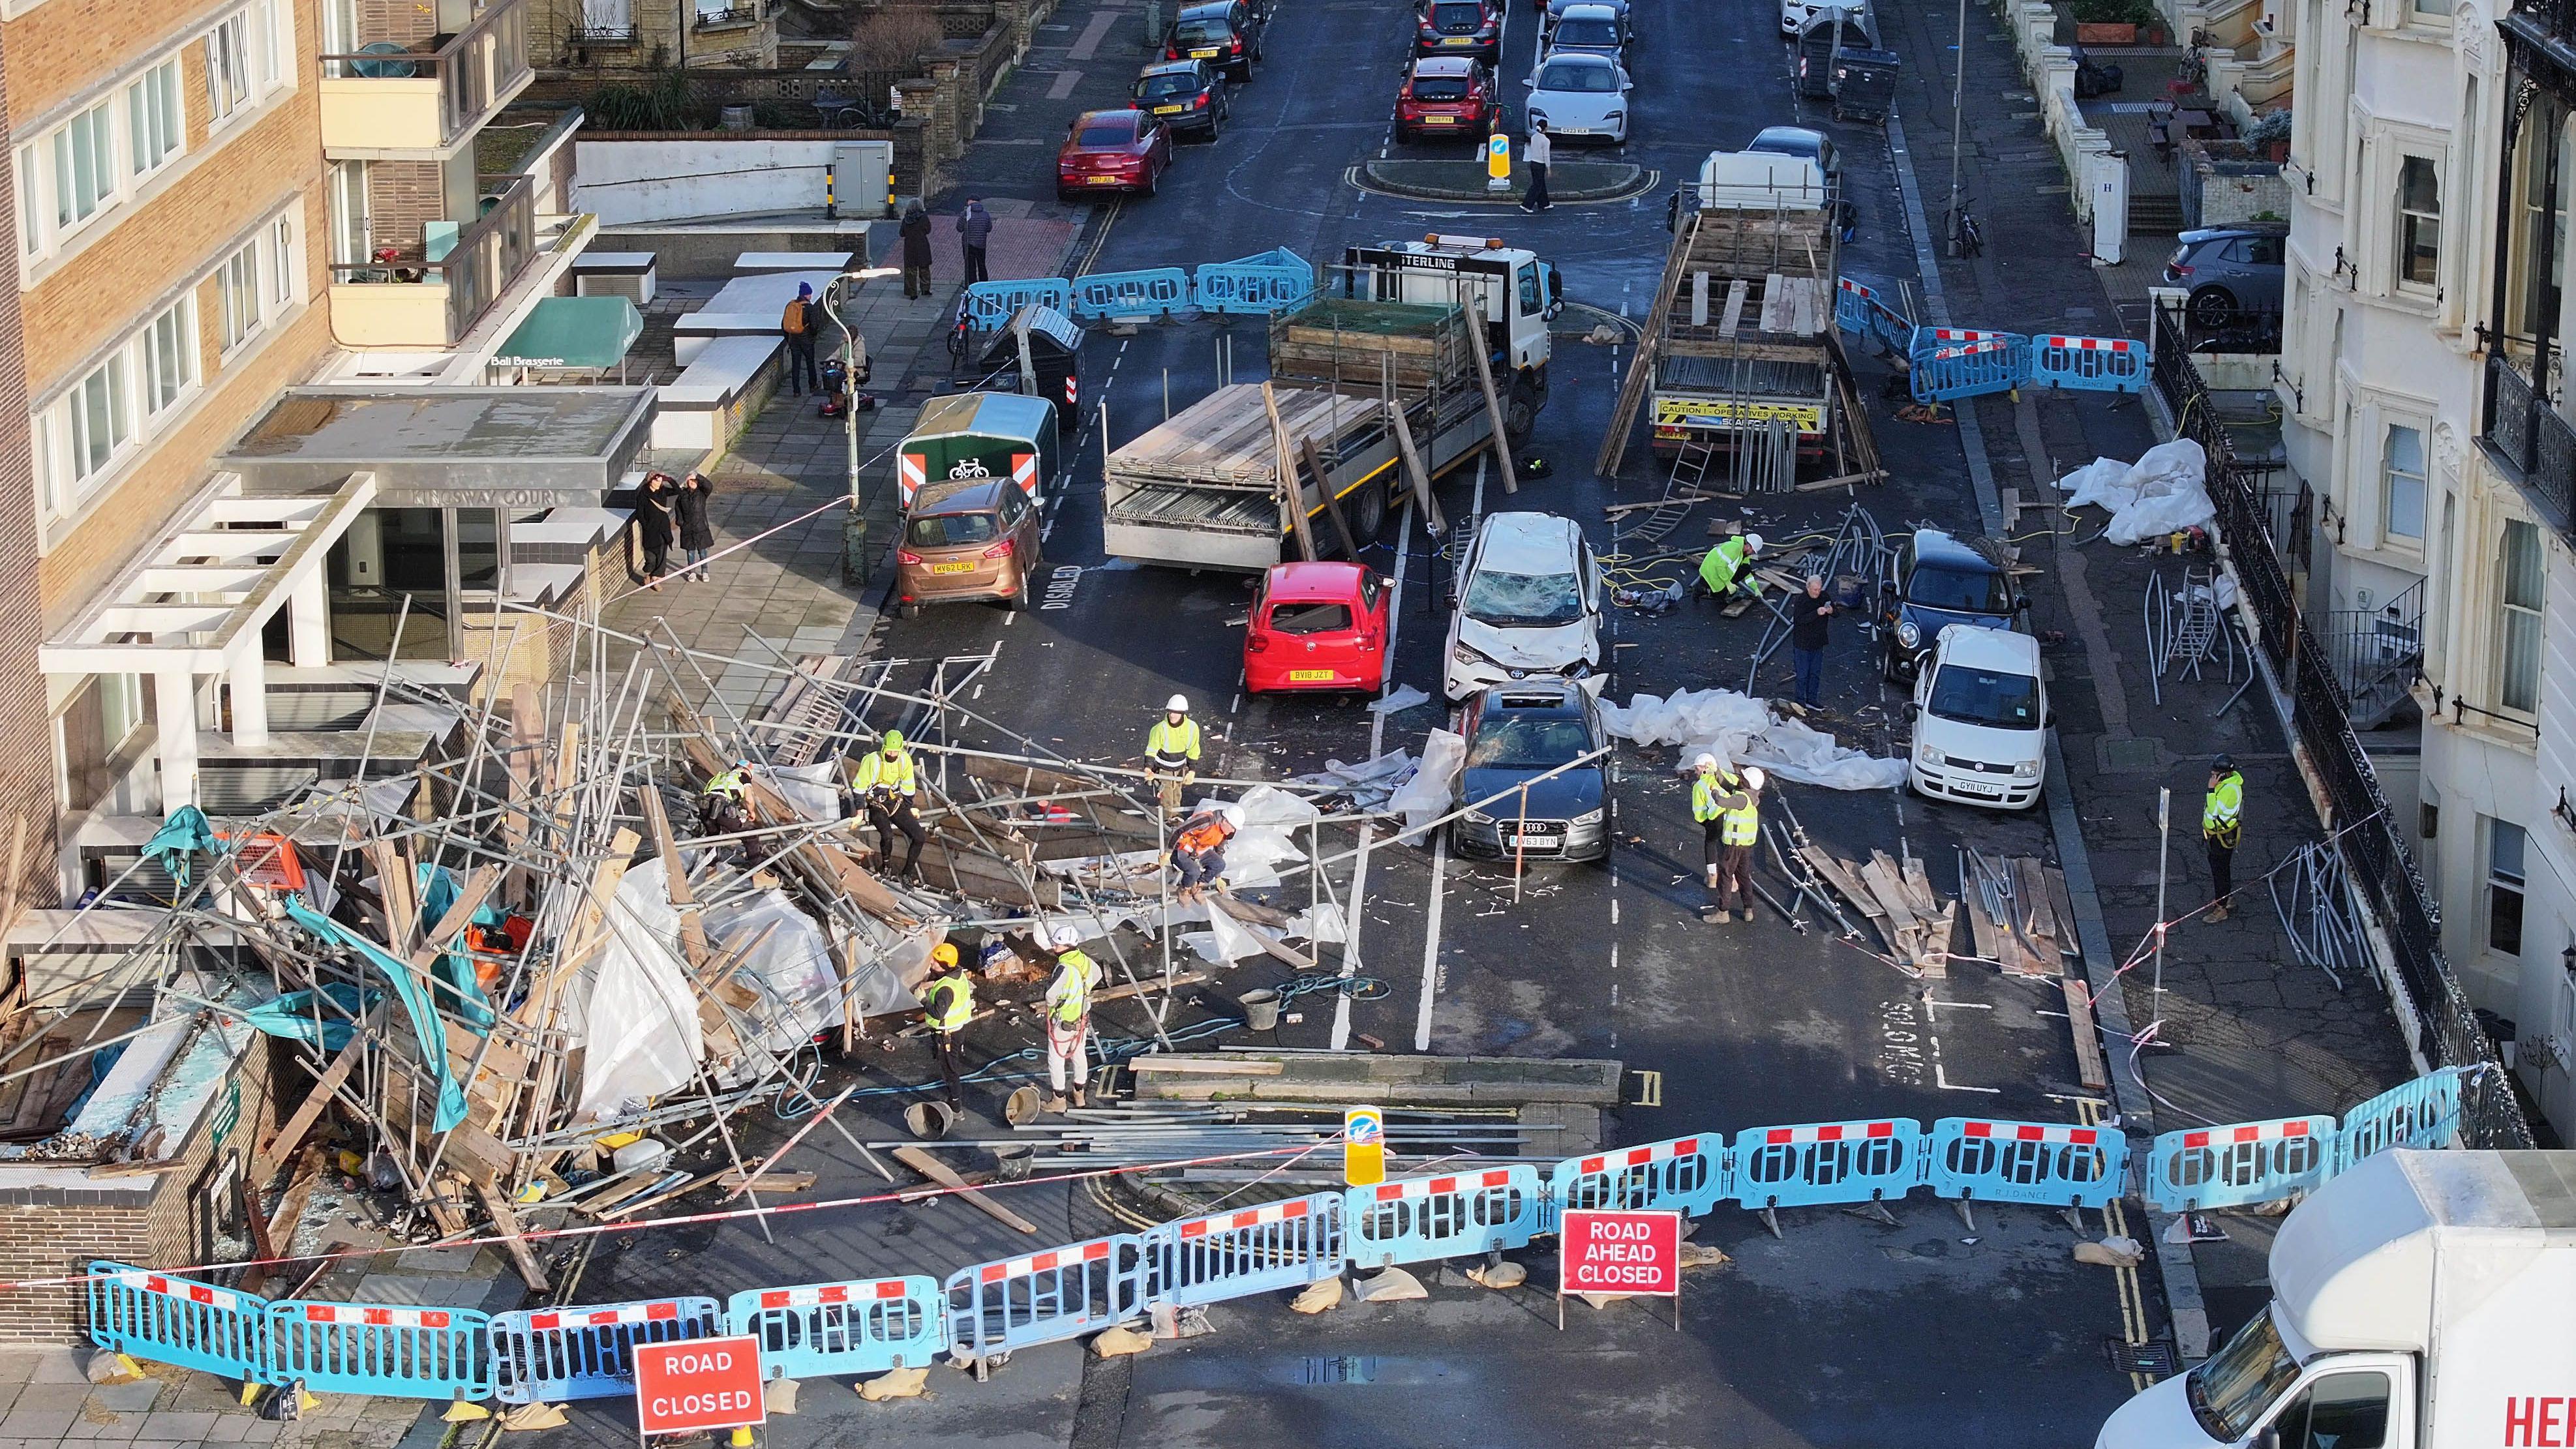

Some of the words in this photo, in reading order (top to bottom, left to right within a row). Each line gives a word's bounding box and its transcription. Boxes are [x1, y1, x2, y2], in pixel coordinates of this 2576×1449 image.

[2104, 183, 2112, 192] H
[491, 357, 511, 366] Bali
[513, 356, 564, 367] Brasserie
[1662, 406, 1701, 414] CAUTION
[412, 490, 494, 505] KINGSWAY
[1040, 565, 1082, 610] DISABLED
[1960, 782, 1975, 790] GY11
[1977, 784, 1992, 793] UYJ
[1590, 1221, 1651, 1240] ROAD
[1584, 1243, 1656, 1262] AHEAD
[1577, 1264, 1662, 1285] CLOSED
[665, 1352, 733, 1375] ROAD
[652, 1390, 751, 1417] CLOSED
